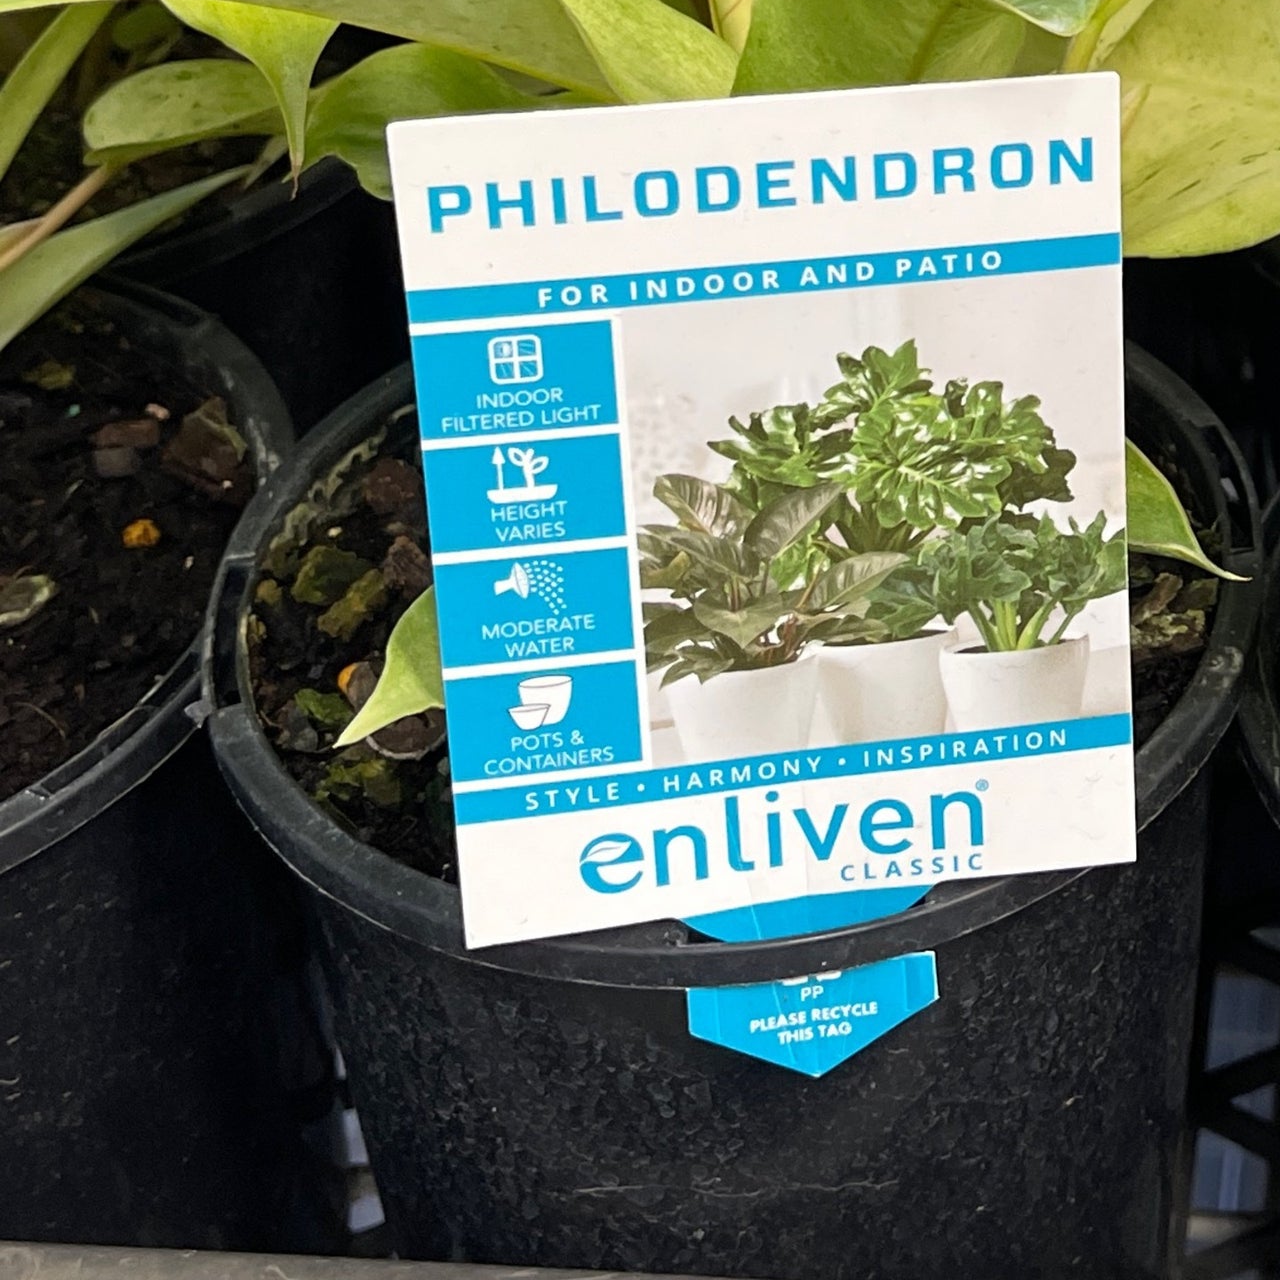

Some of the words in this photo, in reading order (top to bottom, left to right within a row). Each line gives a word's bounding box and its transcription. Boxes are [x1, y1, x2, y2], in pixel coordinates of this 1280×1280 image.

[427, 137, 1093, 233] PHILODENDRON
[538, 284, 608, 308] FOR
[630, 270, 780, 301] INDOOR
[799, 261, 875, 287] AND
[896, 250, 1002, 278] PATIO
[476, 387, 564, 408] INDOOR
[441, 410, 535, 433] FILTERED
[541, 404, 601, 425] LIGHT
[490, 500, 568, 523] HEIGHT
[495, 521, 566, 543] VARIES
[481, 613, 596, 640] MODERATE
[504, 636, 575, 658] WATER
[511, 731, 564, 752] POTS
[570, 729, 585, 746] &
[484, 746, 614, 776] CONTAINERS
[525, 782, 620, 811] STYLE
[663, 756, 822, 794] HARMONY
[863, 728, 1068, 767] INSPIRATION
[840, 852, 984, 882] CLASSIC
[801, 985, 824, 1001] PP
[750, 1011, 807, 1033] PLEASE
[811, 1001, 879, 1022] RECYCLE
[777, 1029, 814, 1045] THIS
[818, 1021, 852, 1038] TAG
